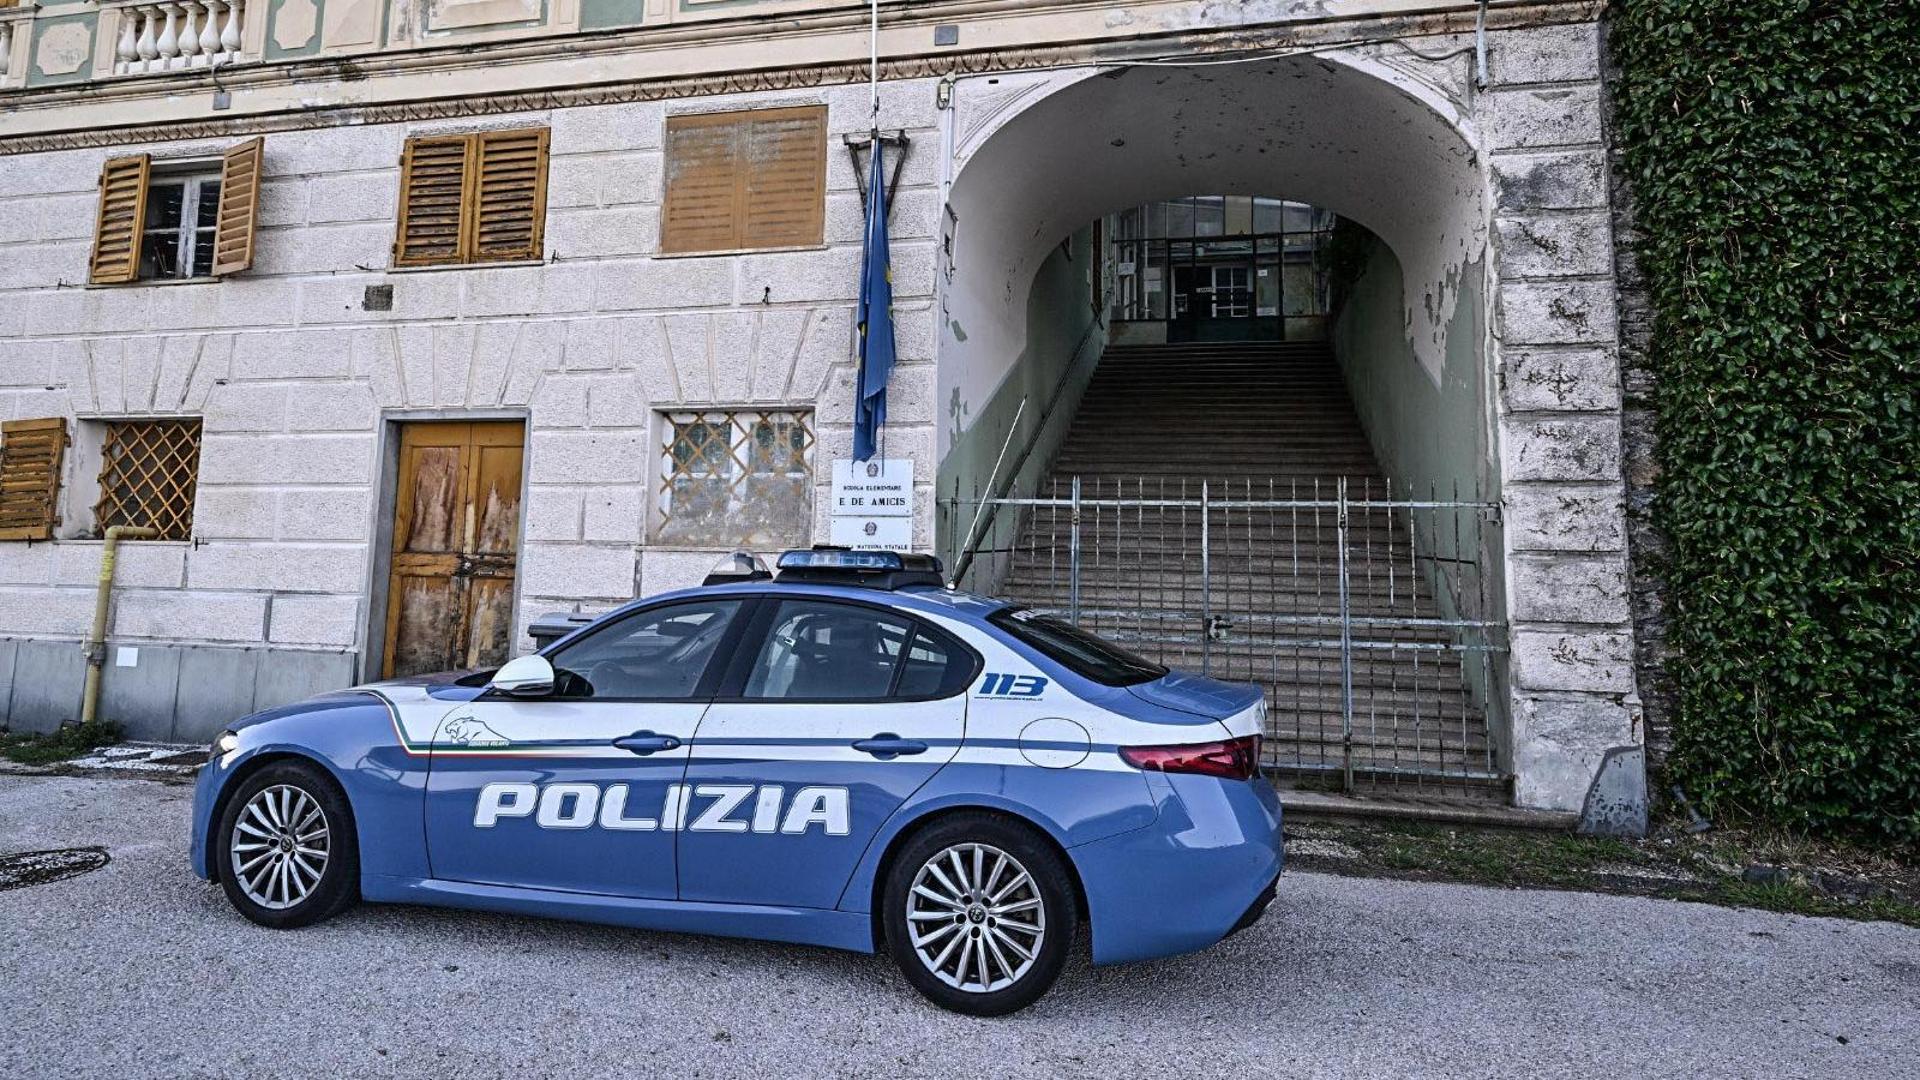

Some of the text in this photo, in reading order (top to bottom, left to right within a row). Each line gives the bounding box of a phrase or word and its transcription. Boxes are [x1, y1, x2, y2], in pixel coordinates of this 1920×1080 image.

[839, 497, 906, 506] E DE AMICIS
[979, 672, 1048, 697] 113
[474, 782, 851, 836] POLIZIA
